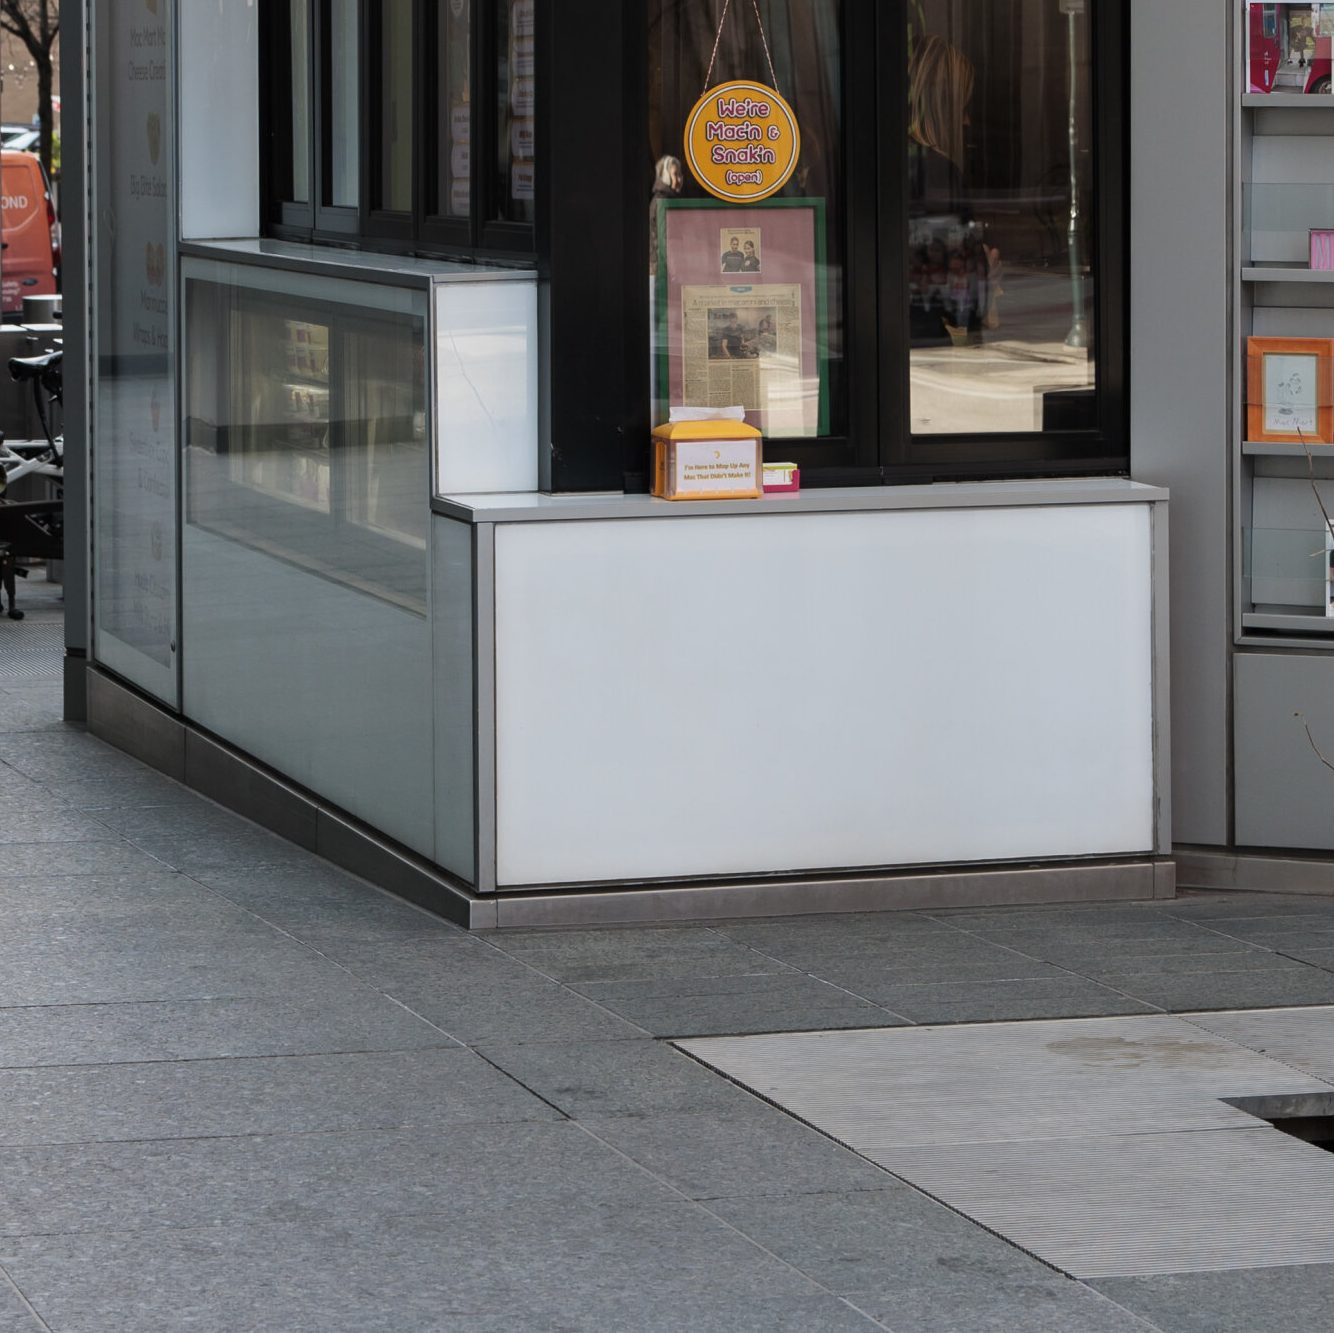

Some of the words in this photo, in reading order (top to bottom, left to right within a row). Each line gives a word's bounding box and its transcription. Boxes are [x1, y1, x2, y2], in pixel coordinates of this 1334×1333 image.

[717, 97, 771, 119] We're
[705, 120, 763, 142] Mac'n
[767, 124, 781, 142] &
[711, 143, 776, 165] Snak'n
[725, 168, 763, 186] (open)
[1, 194, 29, 210] OND
[729, 462, 738, 470] Up
[738, 462, 750, 470] Any
[710, 472, 727, 480] Didn't
